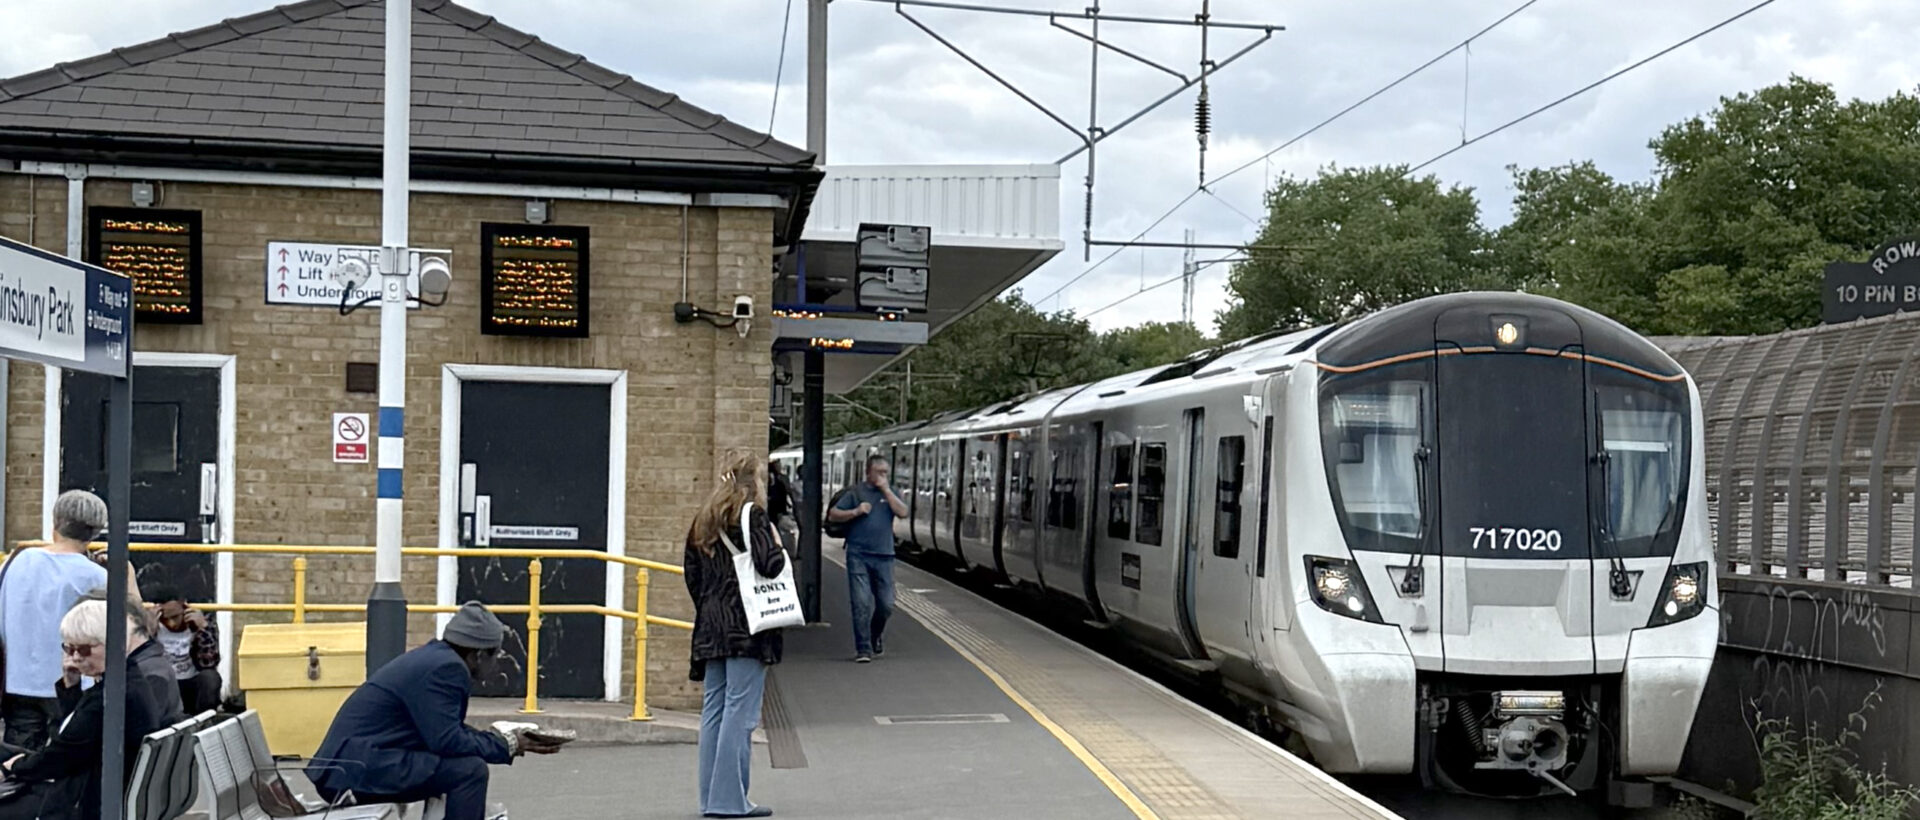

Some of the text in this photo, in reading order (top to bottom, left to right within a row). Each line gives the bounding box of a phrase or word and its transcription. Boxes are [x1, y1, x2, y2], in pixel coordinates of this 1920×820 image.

[298, 249, 332, 266] Way
[298, 267, 323, 281] Lift
[1836, 284, 1858, 303] 10
[1903, 284, 1920, 303] B
[48, 285, 75, 336] Park
[1469, 527, 1562, 552] 717020
